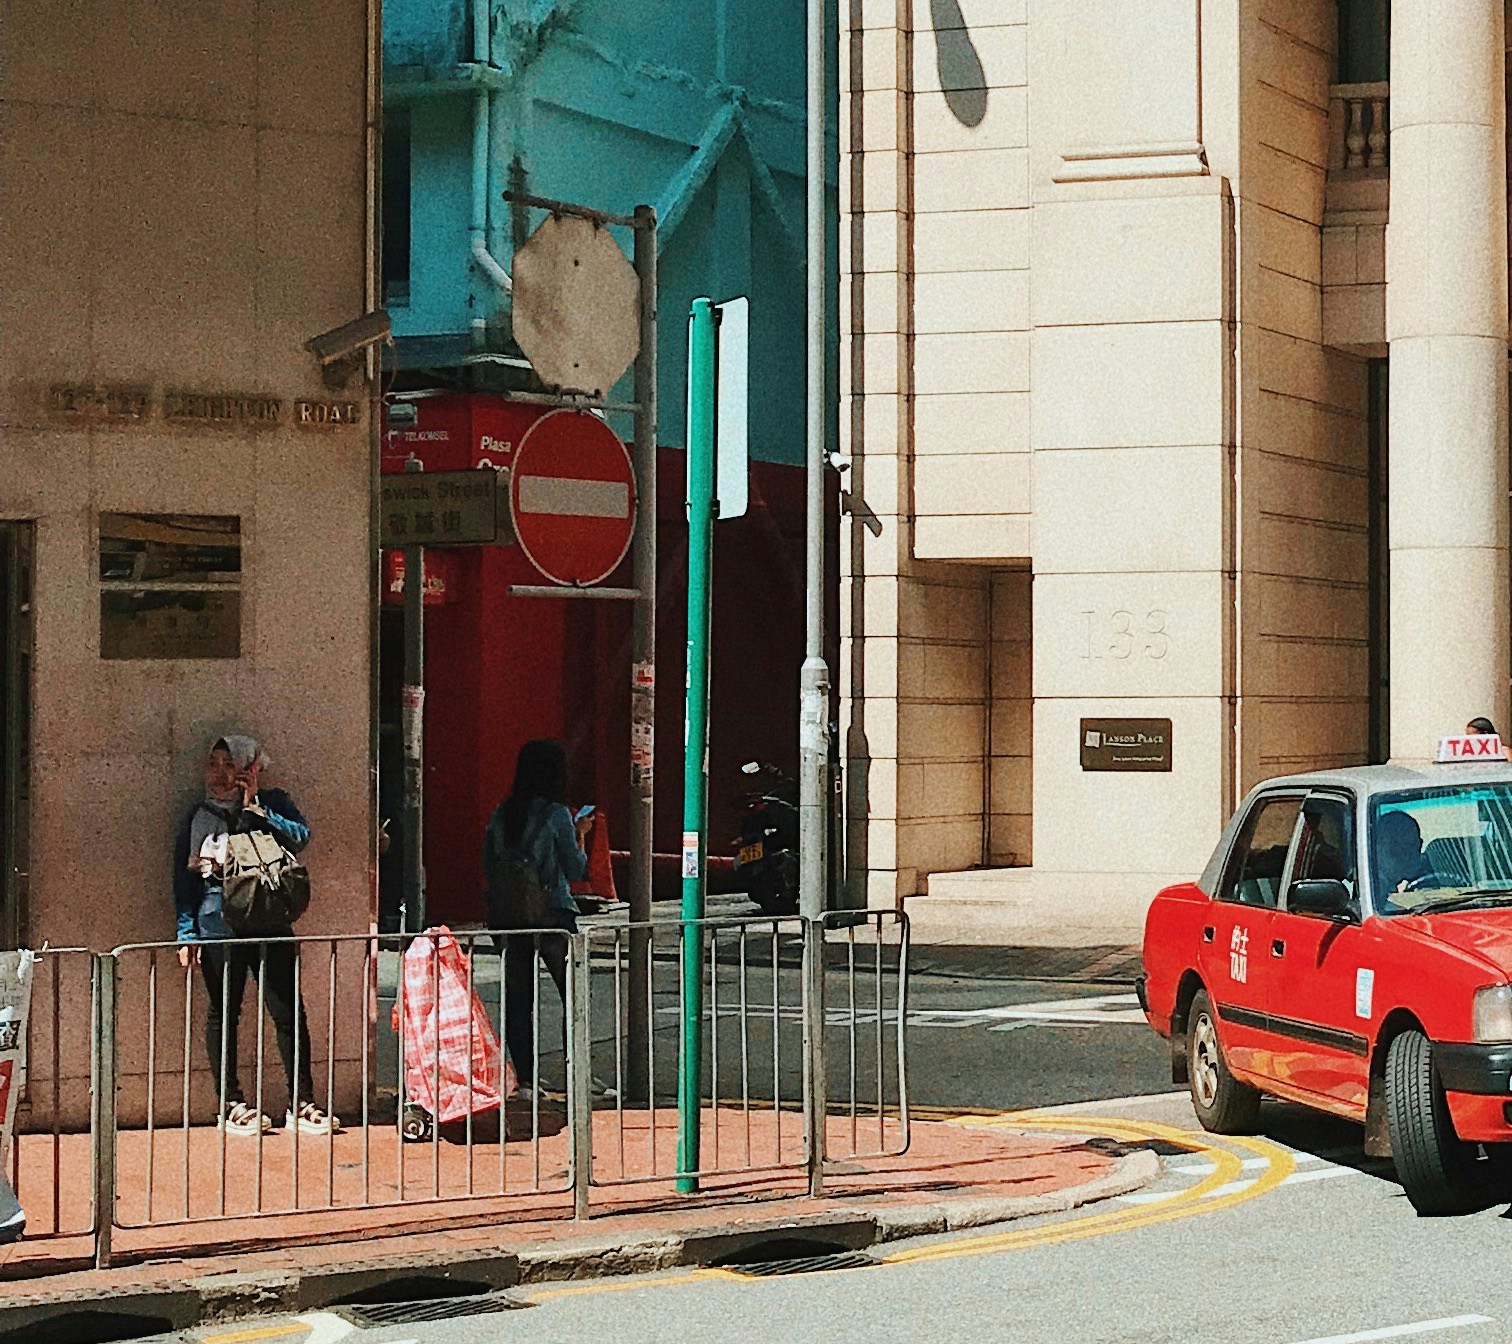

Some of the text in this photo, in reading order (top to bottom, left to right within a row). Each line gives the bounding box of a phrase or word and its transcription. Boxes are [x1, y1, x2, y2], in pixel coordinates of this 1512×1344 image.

[299, 401, 358, 424] ROAD
[405, 430, 449, 441] TELKOMSEL
[480, 435, 512, 453] Plasa
[437, 481, 491, 498] Street
[1081, 609, 1172, 660] 133
[1447, 738, 1499, 757] TAXI
[1231, 925, 1249, 955] 的士
[1230, 951, 1247, 984] TAXI
